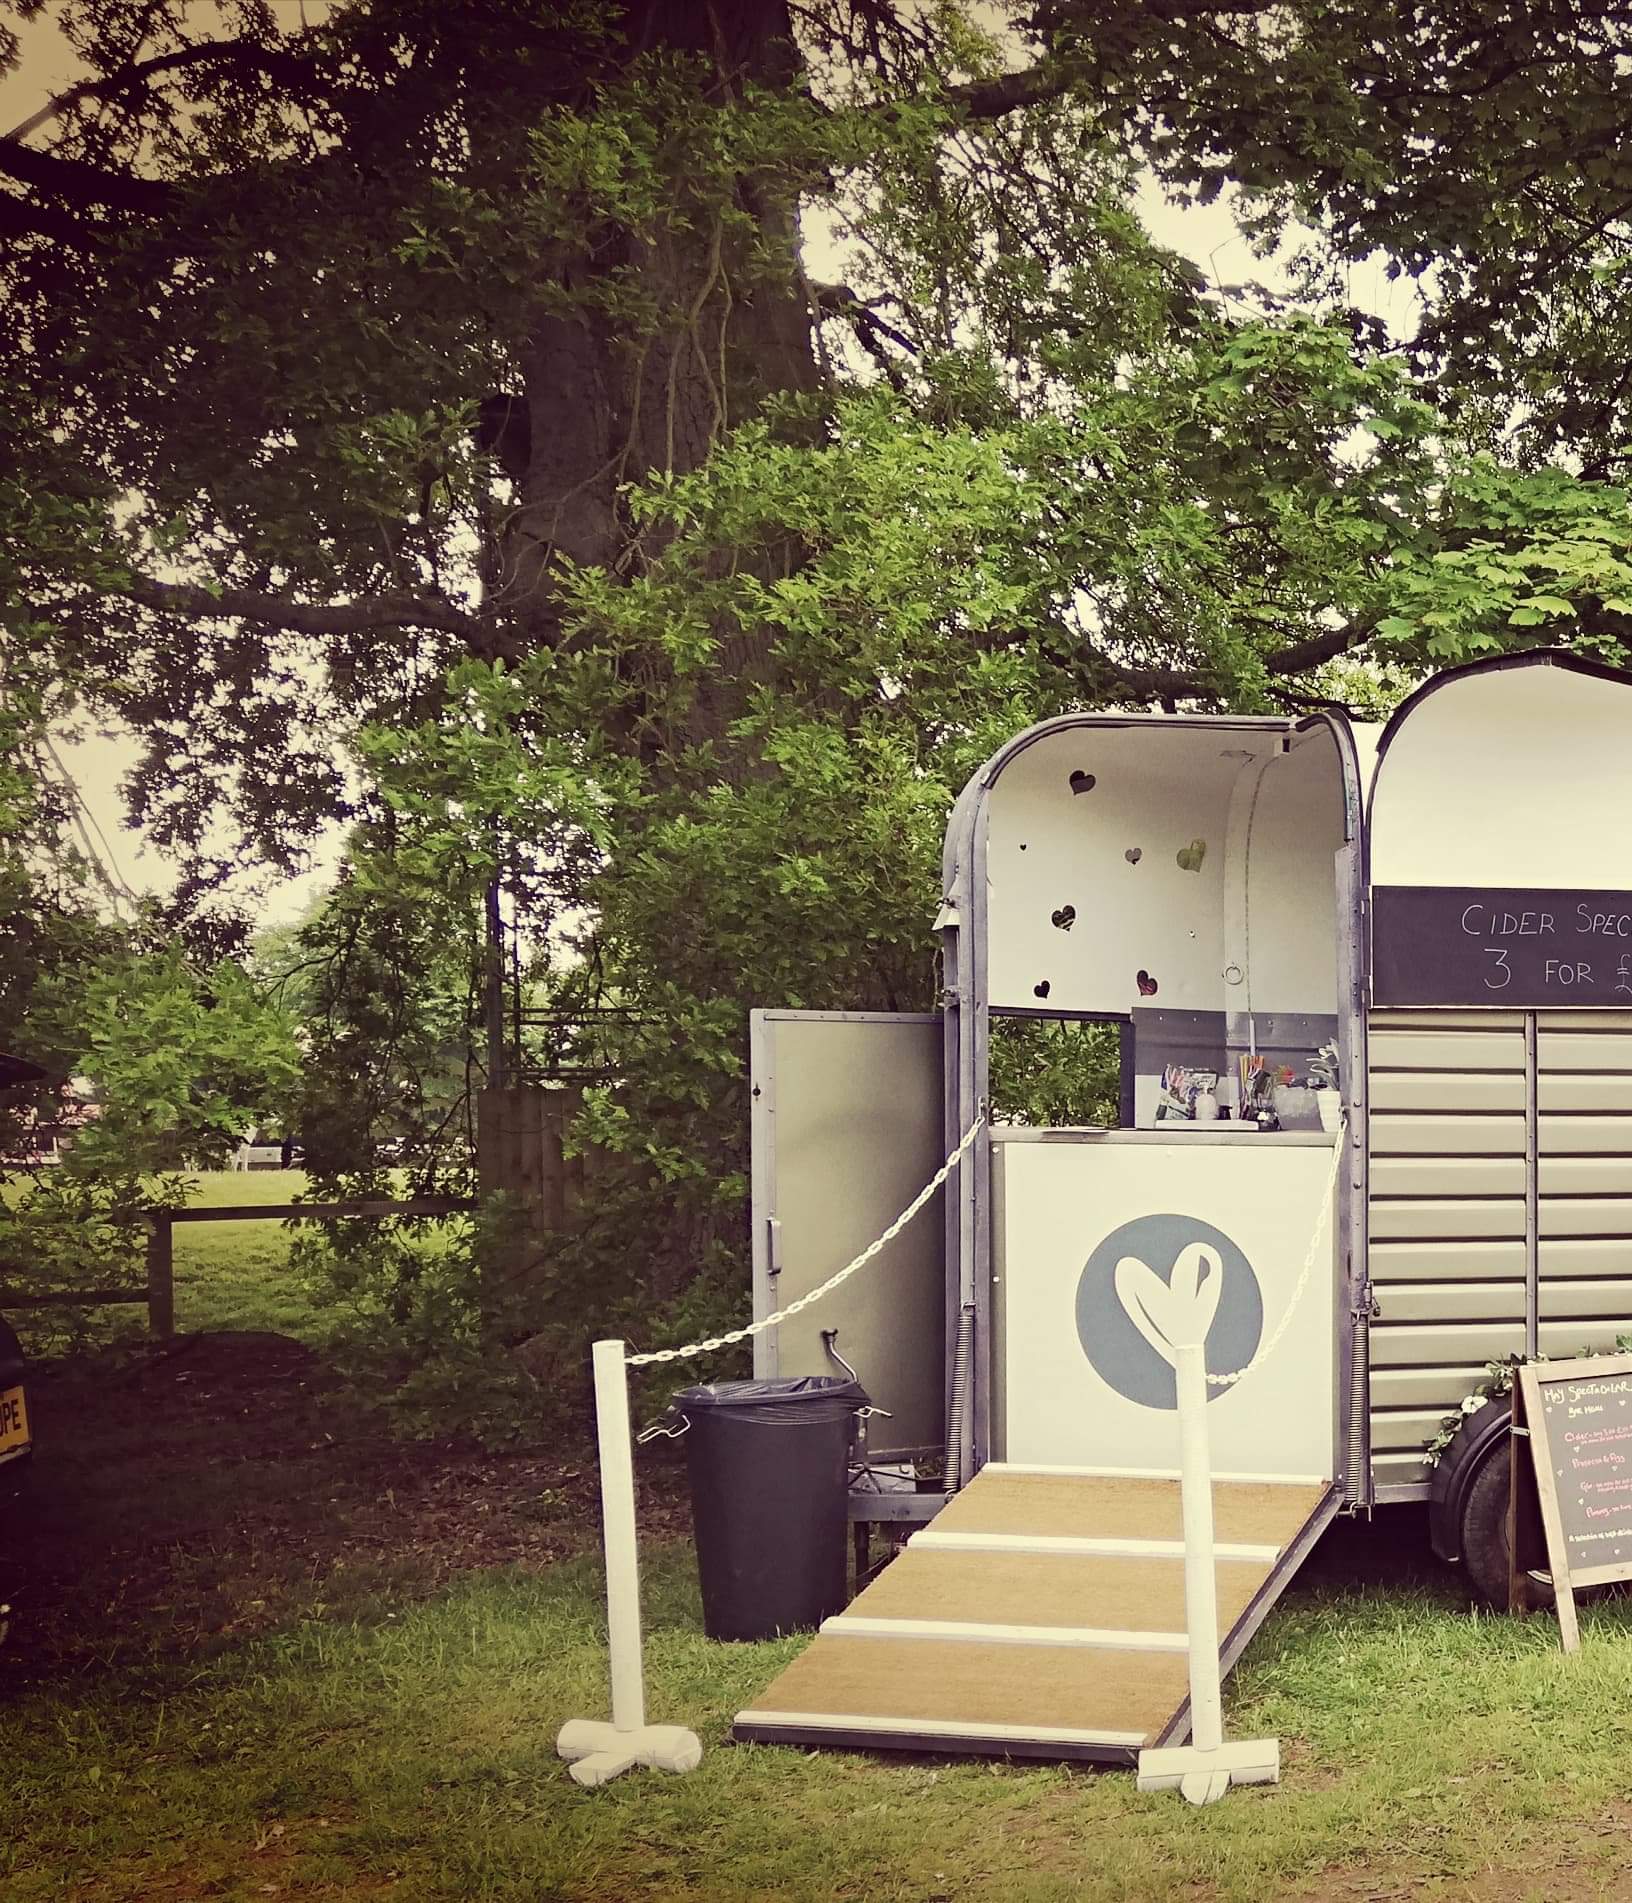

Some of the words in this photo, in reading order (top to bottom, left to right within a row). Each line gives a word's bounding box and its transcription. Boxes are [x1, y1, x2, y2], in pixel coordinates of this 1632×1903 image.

[1461, 904, 1556, 936] CIDER
[1484, 947, 1512, 989] 3
[1545, 959, 1594, 985] FOR
